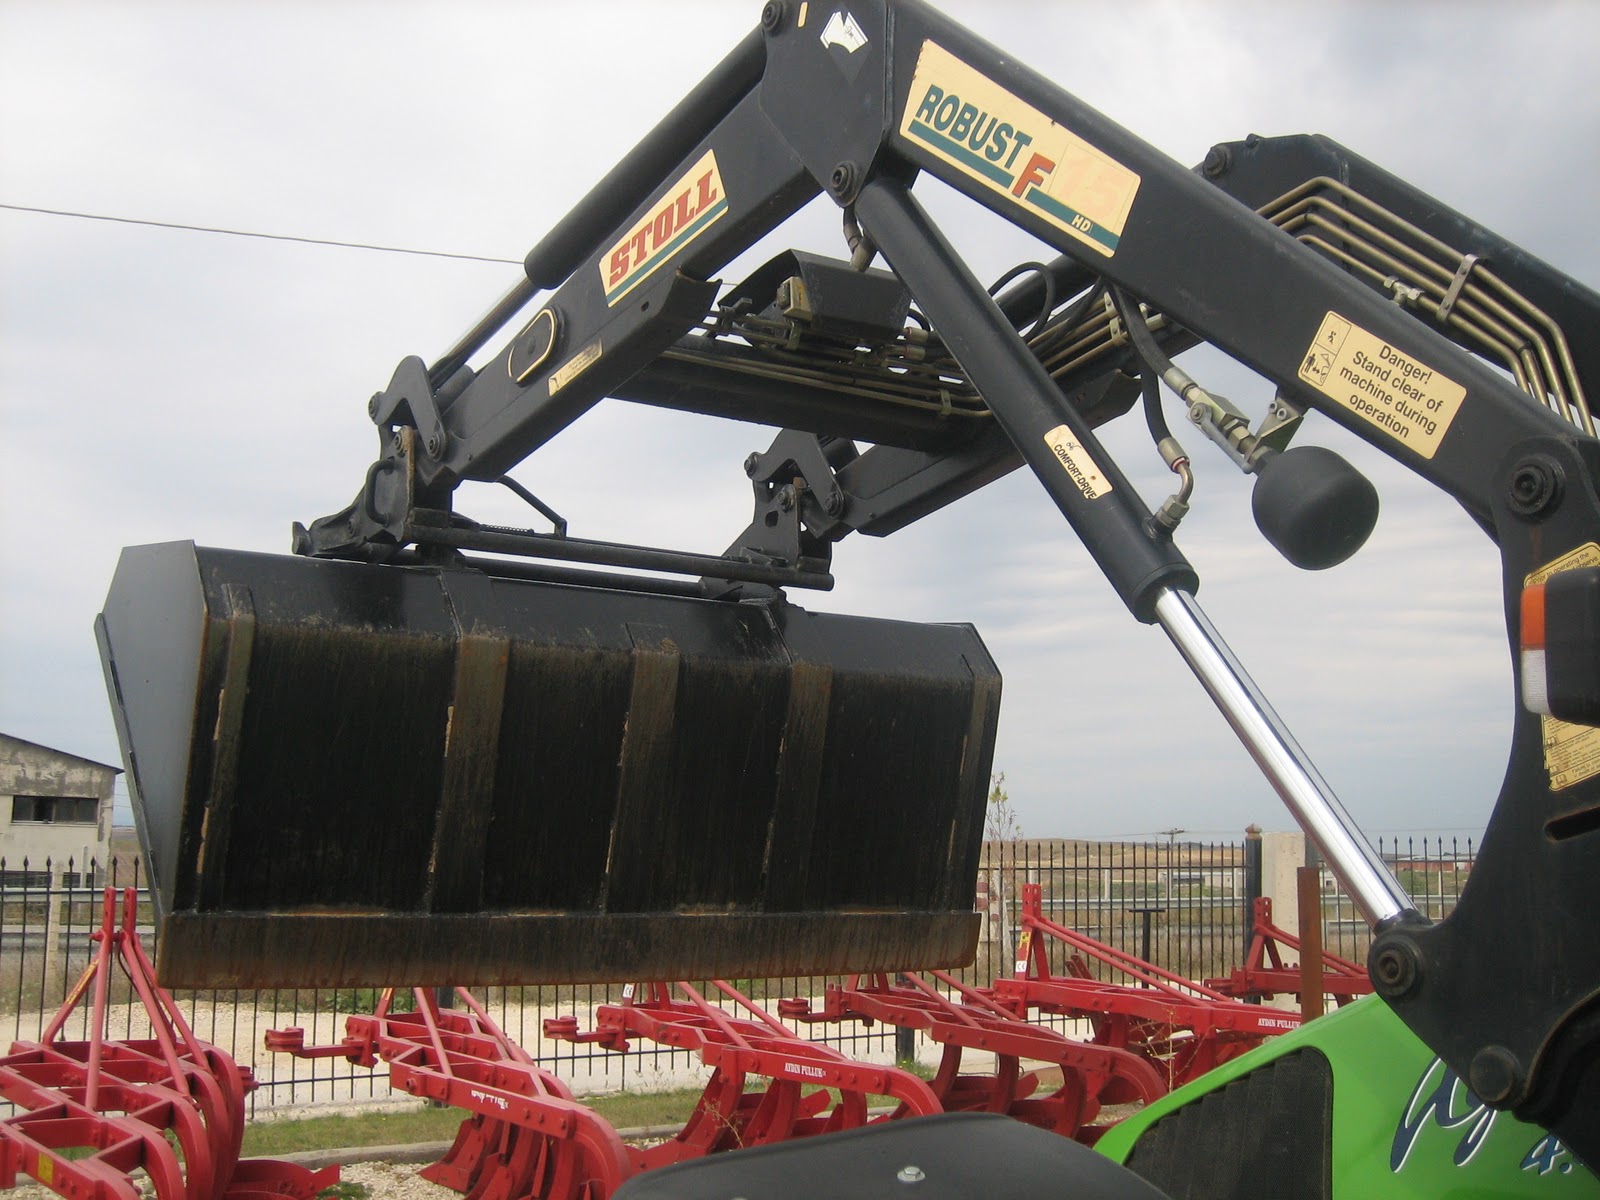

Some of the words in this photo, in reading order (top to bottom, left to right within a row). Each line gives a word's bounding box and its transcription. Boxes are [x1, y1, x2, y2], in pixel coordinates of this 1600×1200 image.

[915, 83, 1033, 170] ROBUST
[1011, 152, 1056, 199] F
[608, 168, 717, 288] STOLL
[1071, 214, 1091, 233] HD
[1352, 350, 1392, 382] Stand
[1391, 377, 1426, 402] clear
[1426, 400, 1444, 413] of
[1378, 345, 1433, 385] Danger!
[1339, 366, 1393, 406] machine
[1394, 399, 1438, 436] during
[1349, 394, 1410, 439] operation
[1053, 444, 1098, 499] COMFORT-DRIVE
